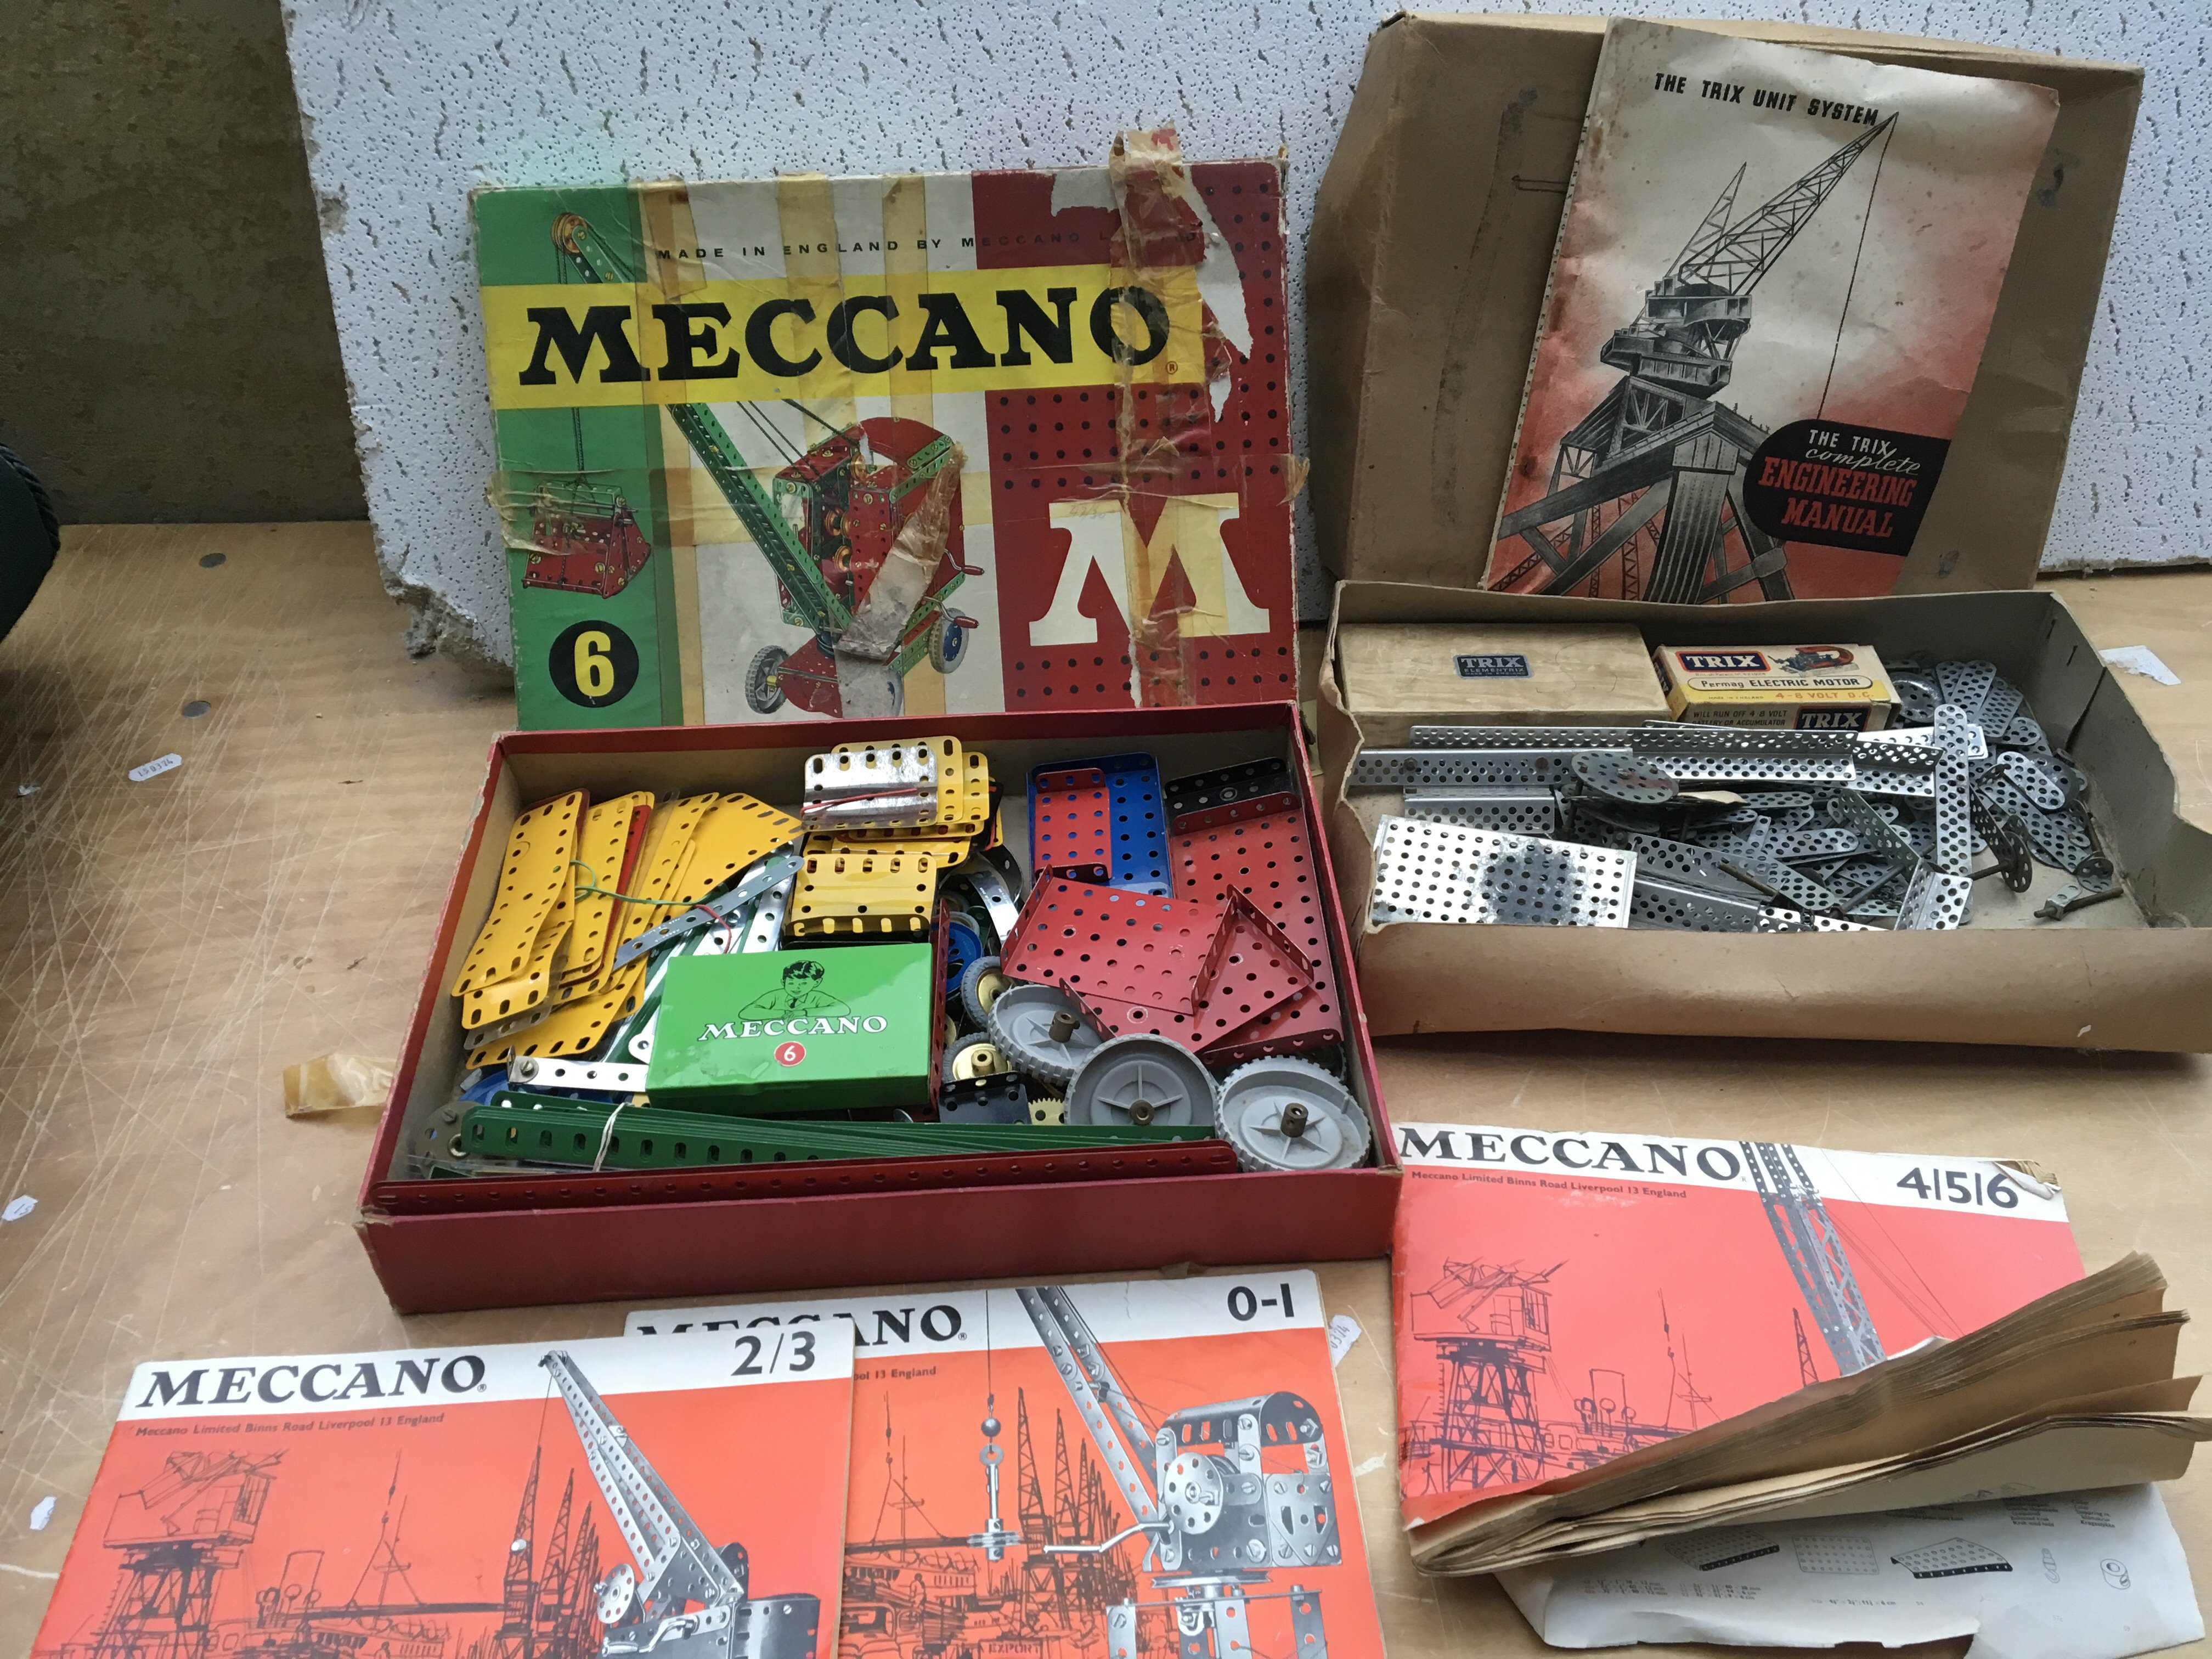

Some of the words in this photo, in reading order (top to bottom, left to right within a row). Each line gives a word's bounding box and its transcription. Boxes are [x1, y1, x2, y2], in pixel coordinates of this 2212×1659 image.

[1655, 72, 1687, 94] THE
[1701, 80, 1745, 104] TRIX
[1753, 89, 1797, 112] UNIT
[1807, 98, 1879, 126] SYSTEM
[1566, 159, 1581, 200] TRIX
[658, 247, 725, 260] MADE
[742, 246, 766, 256] IN
[783, 240, 899, 256] ENGLAND
[917, 238, 942, 250] BY
[961, 232, 1080, 247] MECCANO
[518, 286, 1170, 386] MECCANO
[1809, 429, 1838, 448] THE
[1852, 436, 1891, 455] TRIX
[1805, 447, 1922, 476] complete
[1758, 456, 1918, 507] ENGINEERING
[1781, 497, 1894, 538] MANUAL
[1029, 492, 1271, 647] M
[574, 630, 614, 697] 6
[1460, 657, 1524, 668] TRIX
[1685, 655, 1760, 668] TRIX
[1701, 680, 1745, 689] Permag
[1749, 678, 1809, 687] ELECTRIC
[1813, 678, 1861, 686] MOTOR
[1801, 712, 1863, 729] TRIX
[697, 1015, 888, 1042] MECCANO
[783, 1046, 797, 1062] 6
[1398, 1127, 1741, 1181] MECCANO
[1411, 1170, 1459, 1182] Meccano
[1462, 1172, 1504, 1184] Limited
[1506, 1177, 1537, 1187] Binns
[1539, 1179, 1568, 1189] Road
[1570, 1181, 1624, 1195] Liverpool
[1627, 1186, 1640, 1195] 13
[1642, 1187, 1687, 1199] England
[730, 1330, 816, 1377] 2/3
[135, 1355, 486, 1409] MECCANO
[875, 1370, 886, 1379] 13
[890, 1365, 936, 1380] England
[136, 1426, 188, 1437] Meccano
[193, 1423, 240, 1434] Limited
[245, 1421, 278, 1432] Binns
[282, 1420, 314, 1431] Road
[318, 1417, 376, 1432] Liverpool
[379, 1417, 393, 1427] 13
[397, 1413, 444, 1427] England
